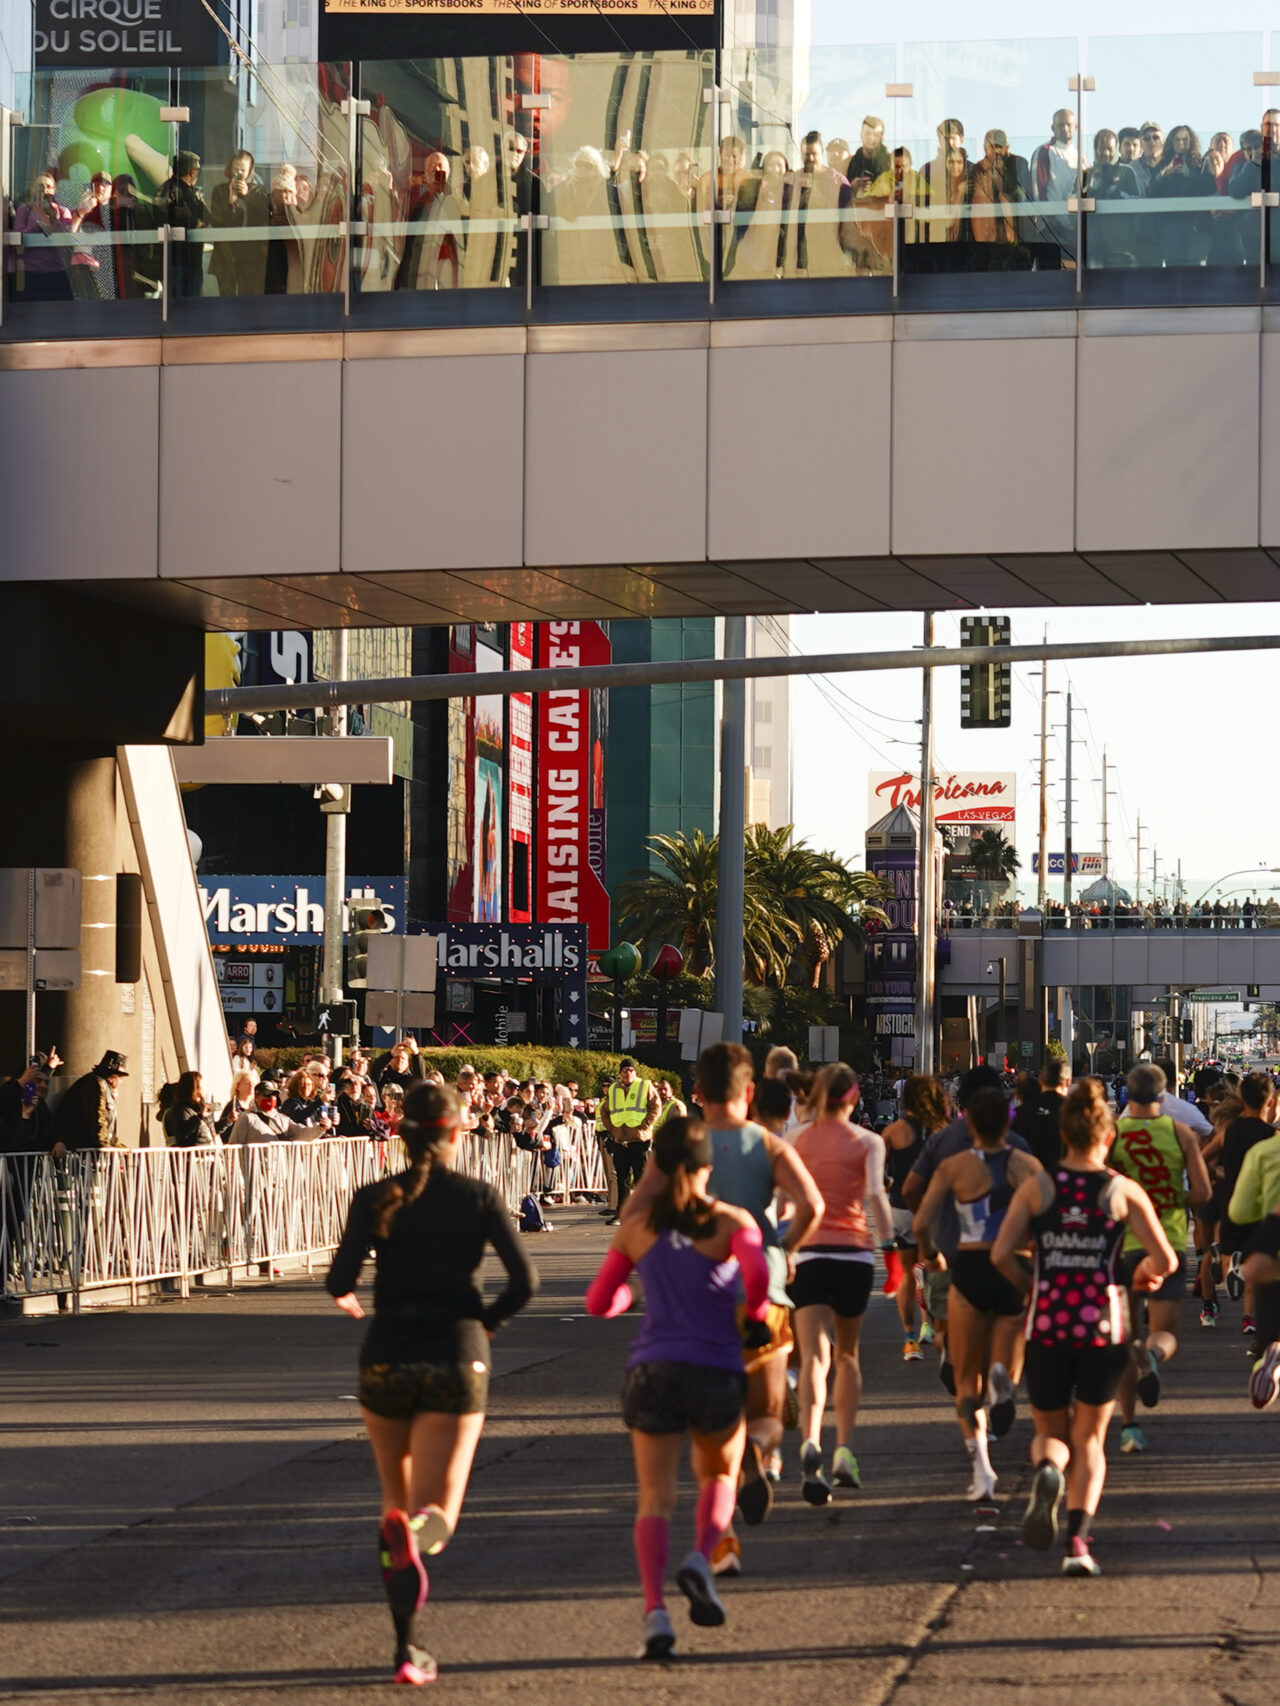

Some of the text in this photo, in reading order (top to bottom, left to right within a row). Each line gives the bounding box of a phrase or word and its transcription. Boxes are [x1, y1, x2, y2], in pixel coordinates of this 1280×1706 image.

[338, 0, 357, 8] THE
[360, 0, 386, 8] KING
[405, 0, 483, 8] SPORTSBOOKS
[514, 0, 542, 8] KING
[560, 0, 638, 8] SPORTSBOOKS
[670, 0, 697, 8] KING
[50, 0, 162, 26] CIRQUE
[79, 29, 183, 53] SOLEIL
[957, 811, 1013, 820] LAS VEGAS
